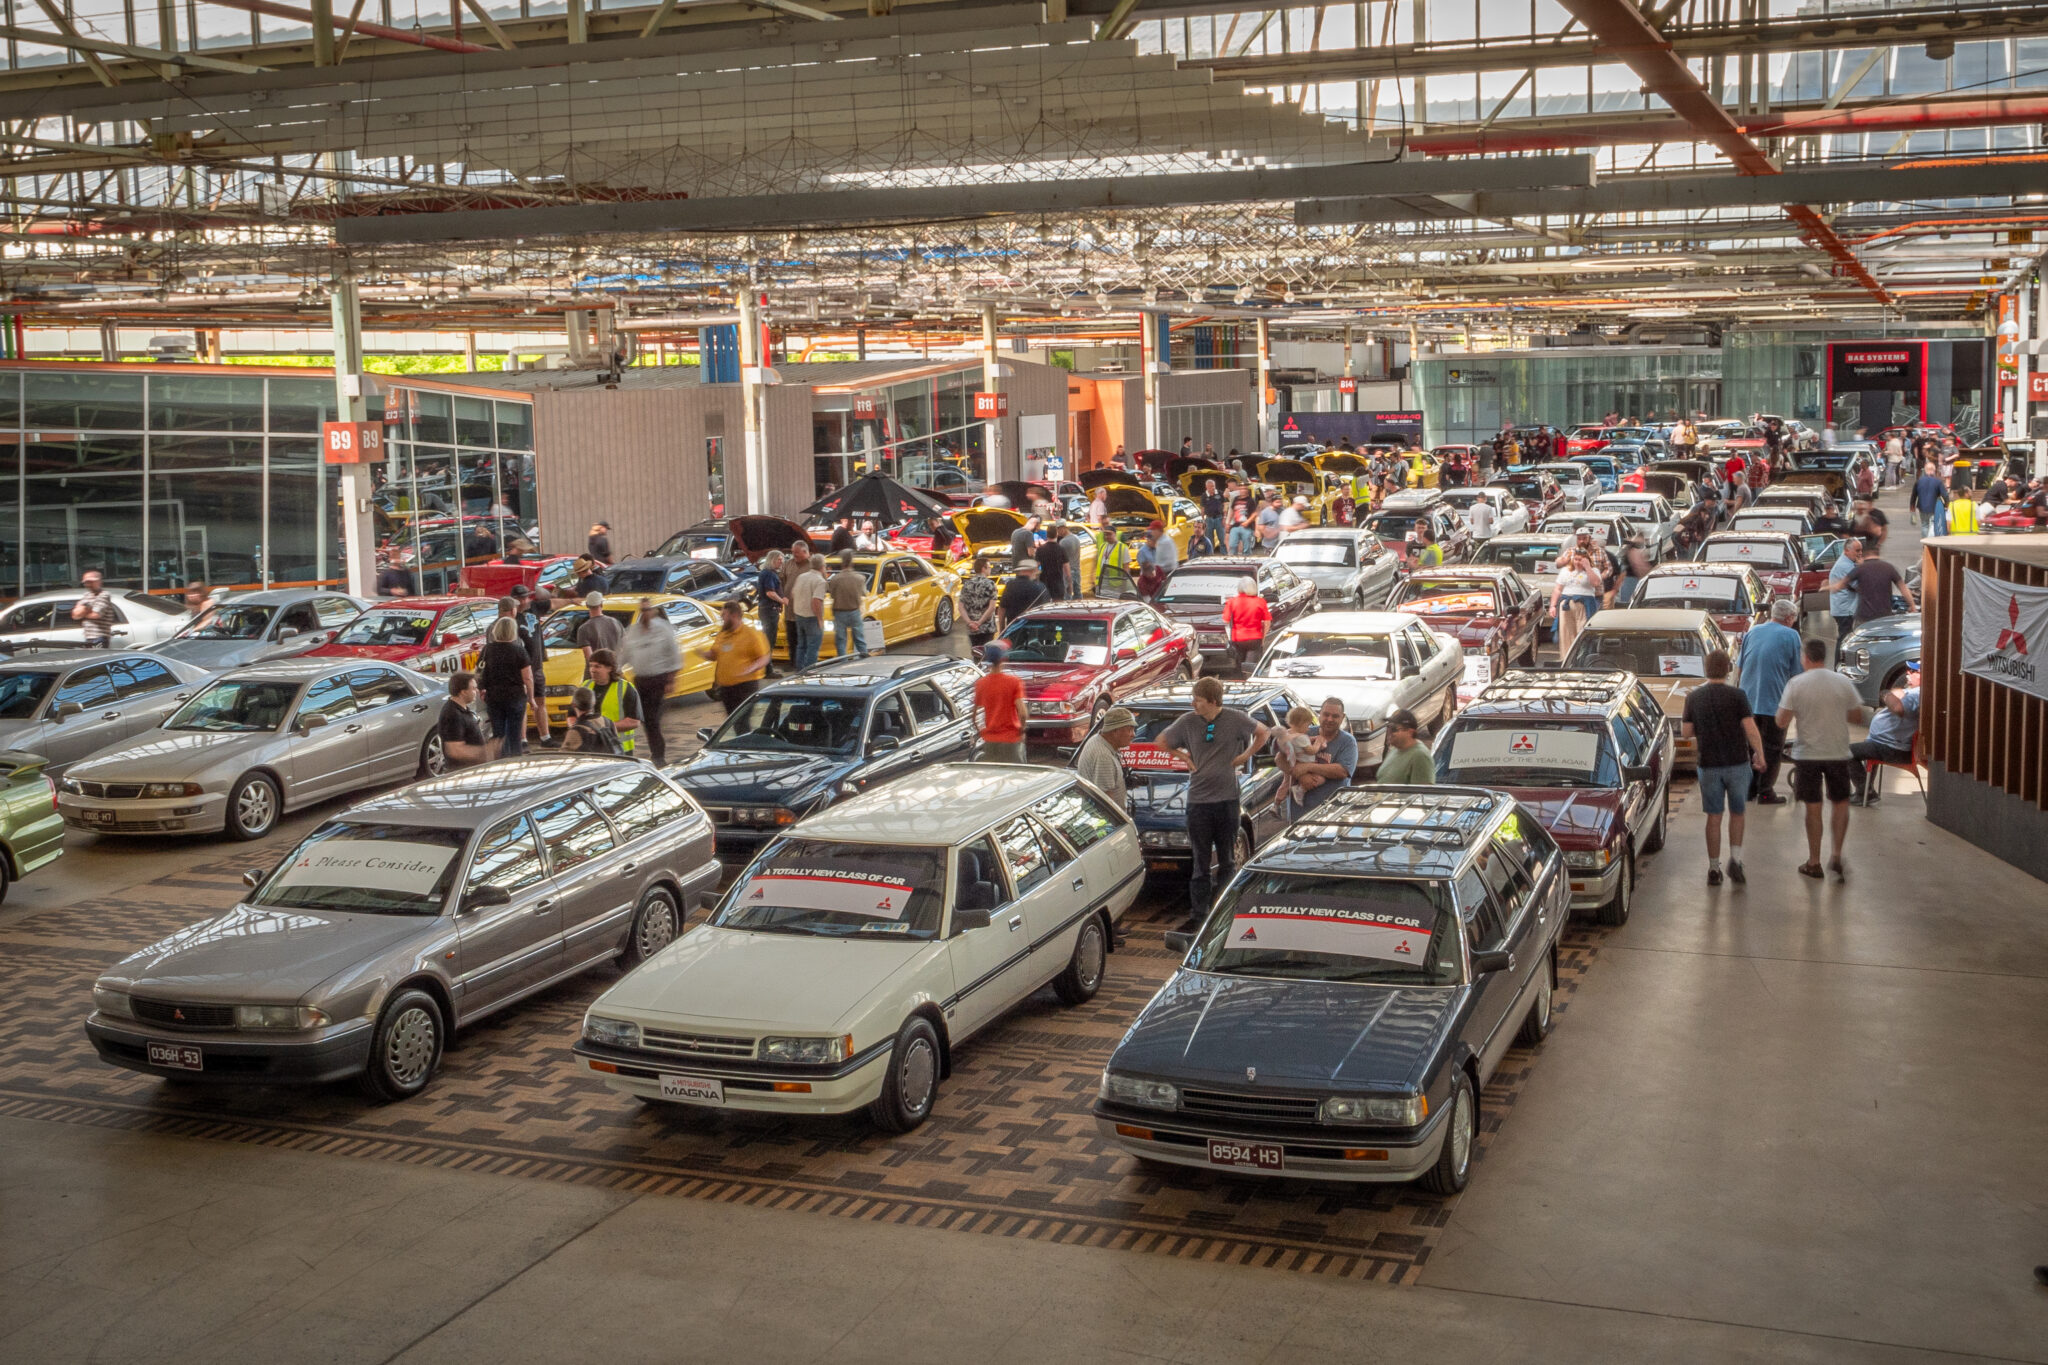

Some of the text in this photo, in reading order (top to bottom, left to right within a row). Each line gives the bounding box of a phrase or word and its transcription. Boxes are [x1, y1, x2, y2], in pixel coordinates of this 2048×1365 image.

[1340, 380, 1353, 388] B14
[978, 397, 994, 410] B11
[997, 398, 1007, 410] B11
[330, 430, 351, 450] B9
[363, 430, 379, 449] B9
[410, 618, 431, 628] 40
[440, 654, 458, 673] 40
[1987, 654, 2036, 682] MITSUBISHI
[314, 856, 436, 874] Please Consider.
[772, 868, 812, 876] TOTALLY
[812, 869, 835, 877] NEW
[836, 871, 869, 880] CLASS
[870, 874, 883, 882] OF
[883, 876, 906, 886] CAR
[1249, 905, 1420, 928] A TOTALLY NEW CLASS OF CAR
[664, 1086, 720, 1100] MAGNA
